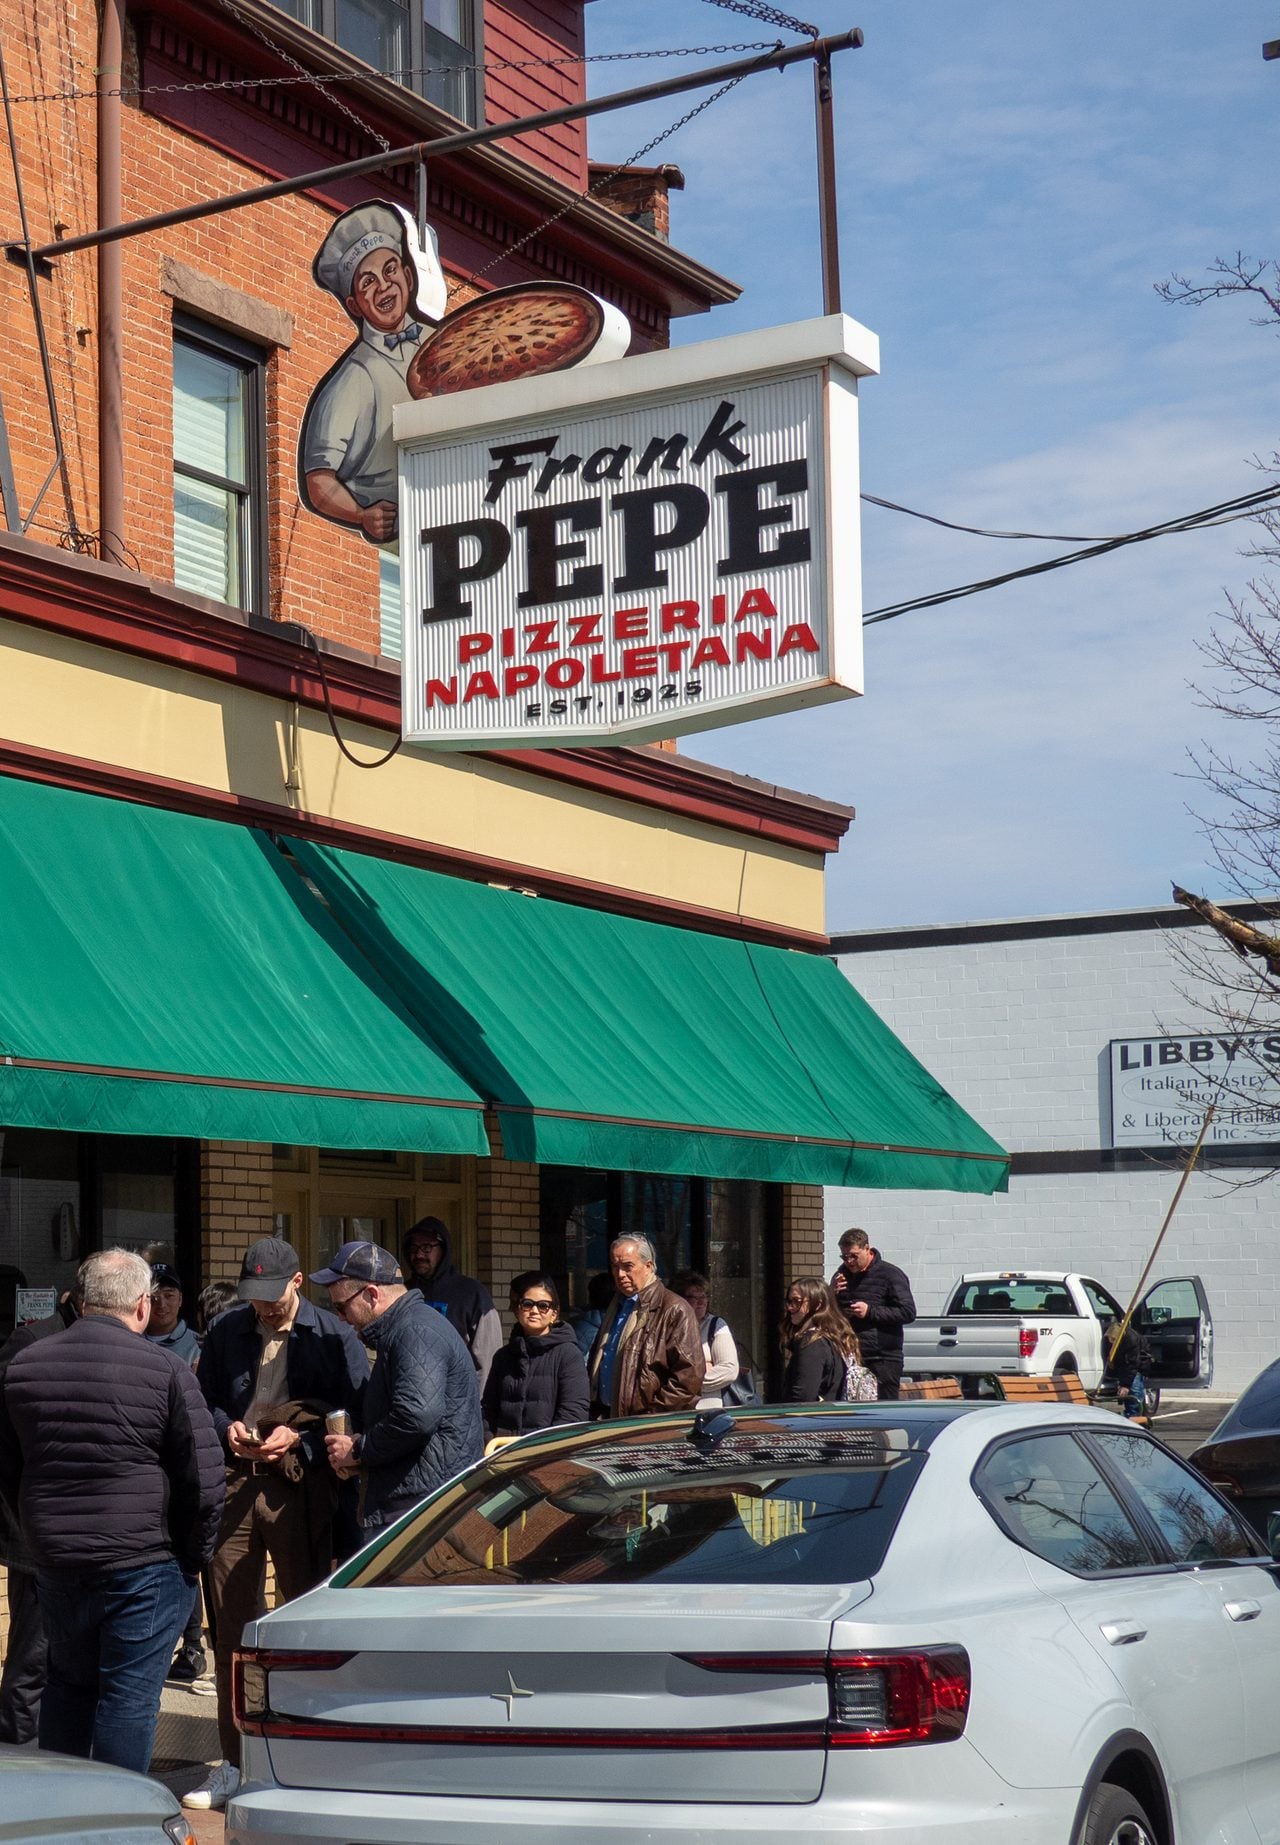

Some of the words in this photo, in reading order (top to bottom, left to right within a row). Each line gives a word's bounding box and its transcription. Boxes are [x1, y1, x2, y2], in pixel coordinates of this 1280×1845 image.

[483, 400, 751, 503] Frank
[420, 458, 812, 625] PEPE
[458, 587, 778, 664] PIZZERIA
[426, 622, 820, 708] NAPOLETANA
[526, 695, 604, 718] EST.
[617, 679, 703, 704] 1925
[1141, 1076, 1198, 1091] Italian
[1208, 1074, 1269, 1088] Pastry
[1179, 1090, 1226, 1105] Shop
[1122, 1113, 1136, 1128] &
[1145, 1112, 1221, 1127] Liberato
[1162, 1128, 1198, 1141] Ices
[1213, 1126, 1247, 1140] Inc.
[1040, 1328, 1053, 1336] STX
